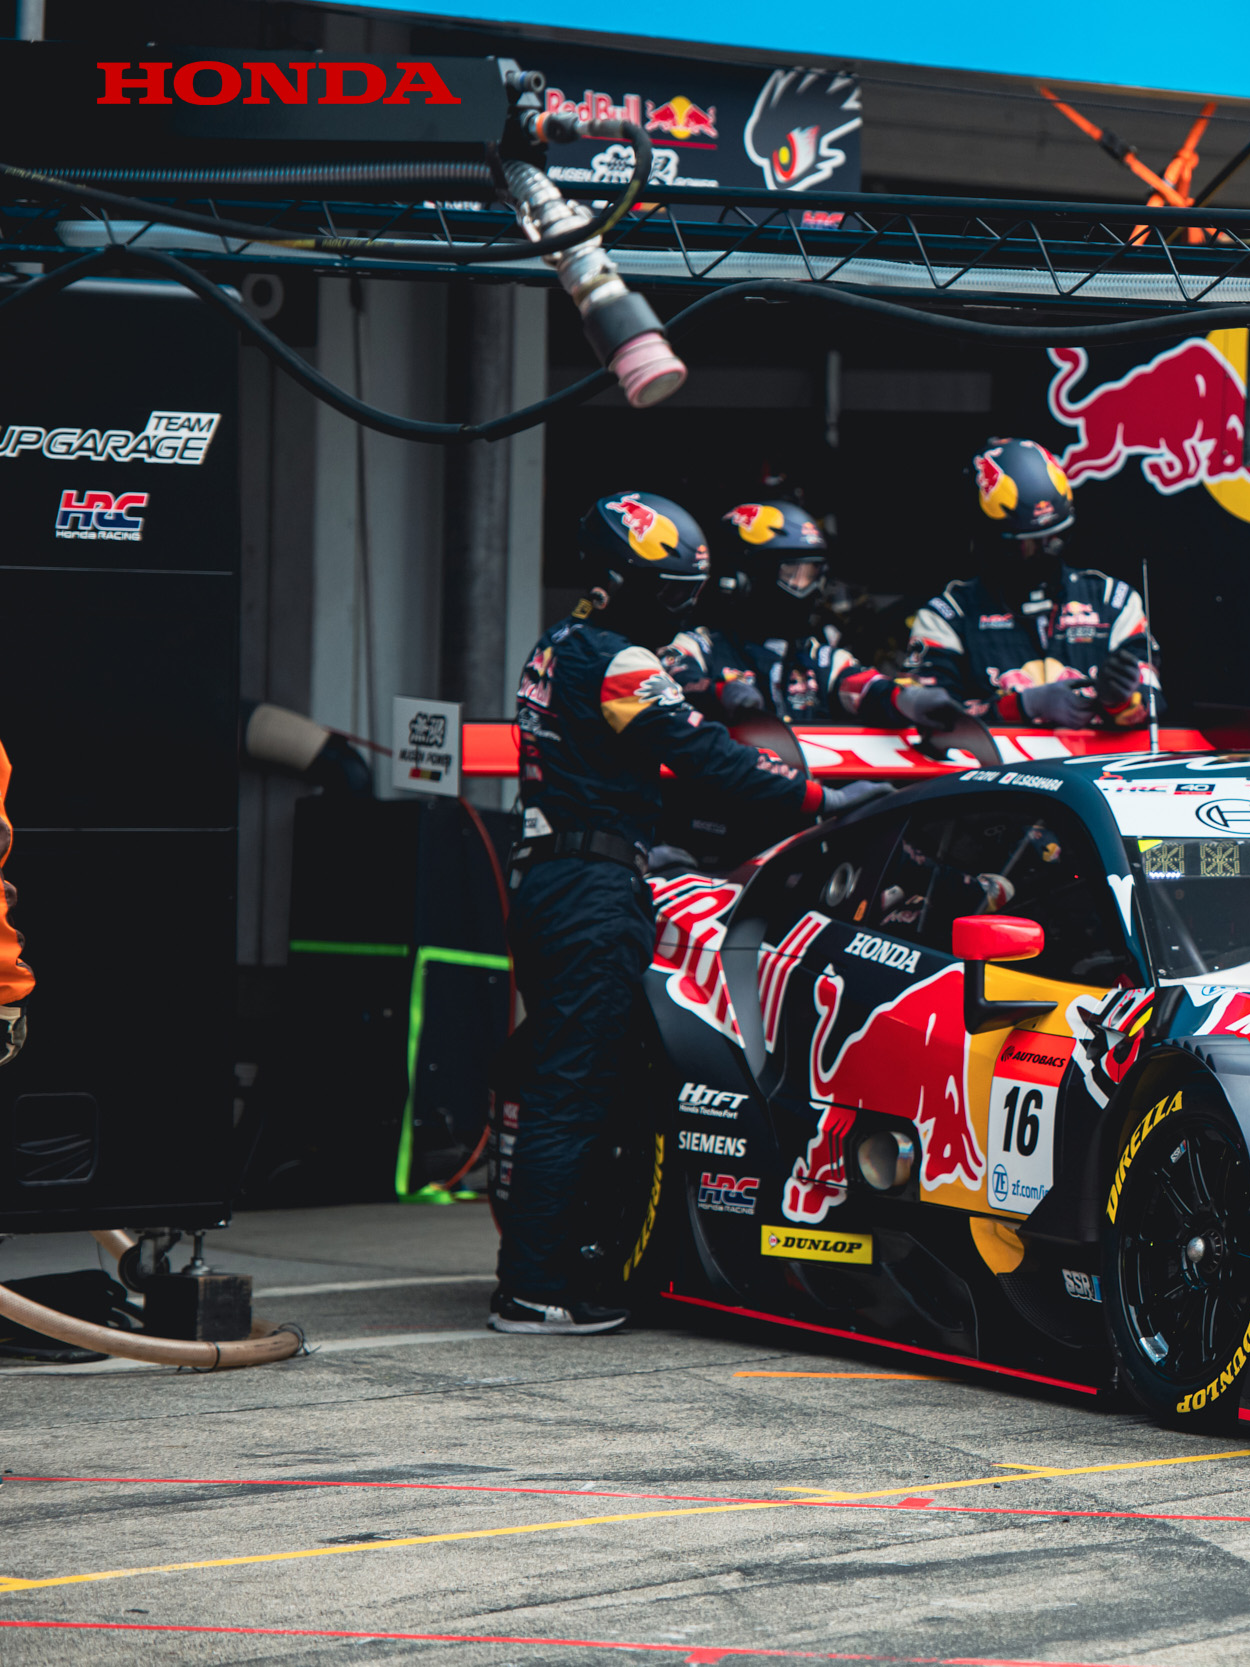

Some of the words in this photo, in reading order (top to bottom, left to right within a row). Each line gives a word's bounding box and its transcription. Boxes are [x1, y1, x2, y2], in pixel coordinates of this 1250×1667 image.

[152, 416, 215, 433] TEAM
[55, 489, 149, 530] HRC
[56, 530, 96, 539] Honda
[97, 531, 141, 541] RACING
[845, 932, 921, 973] HONDA
[1012, 1051, 1066, 1068] AUTOBACS
[678, 1082, 749, 1110] HTFT
[1003, 1086, 1043, 1156] 16
[678, 1130, 747, 1157] SIEMENS
[1106, 1091, 1183, 1224] DIREZZA
[698, 1172, 760, 1208] HRC
[782, 1236, 863, 1254] DUNLOP
